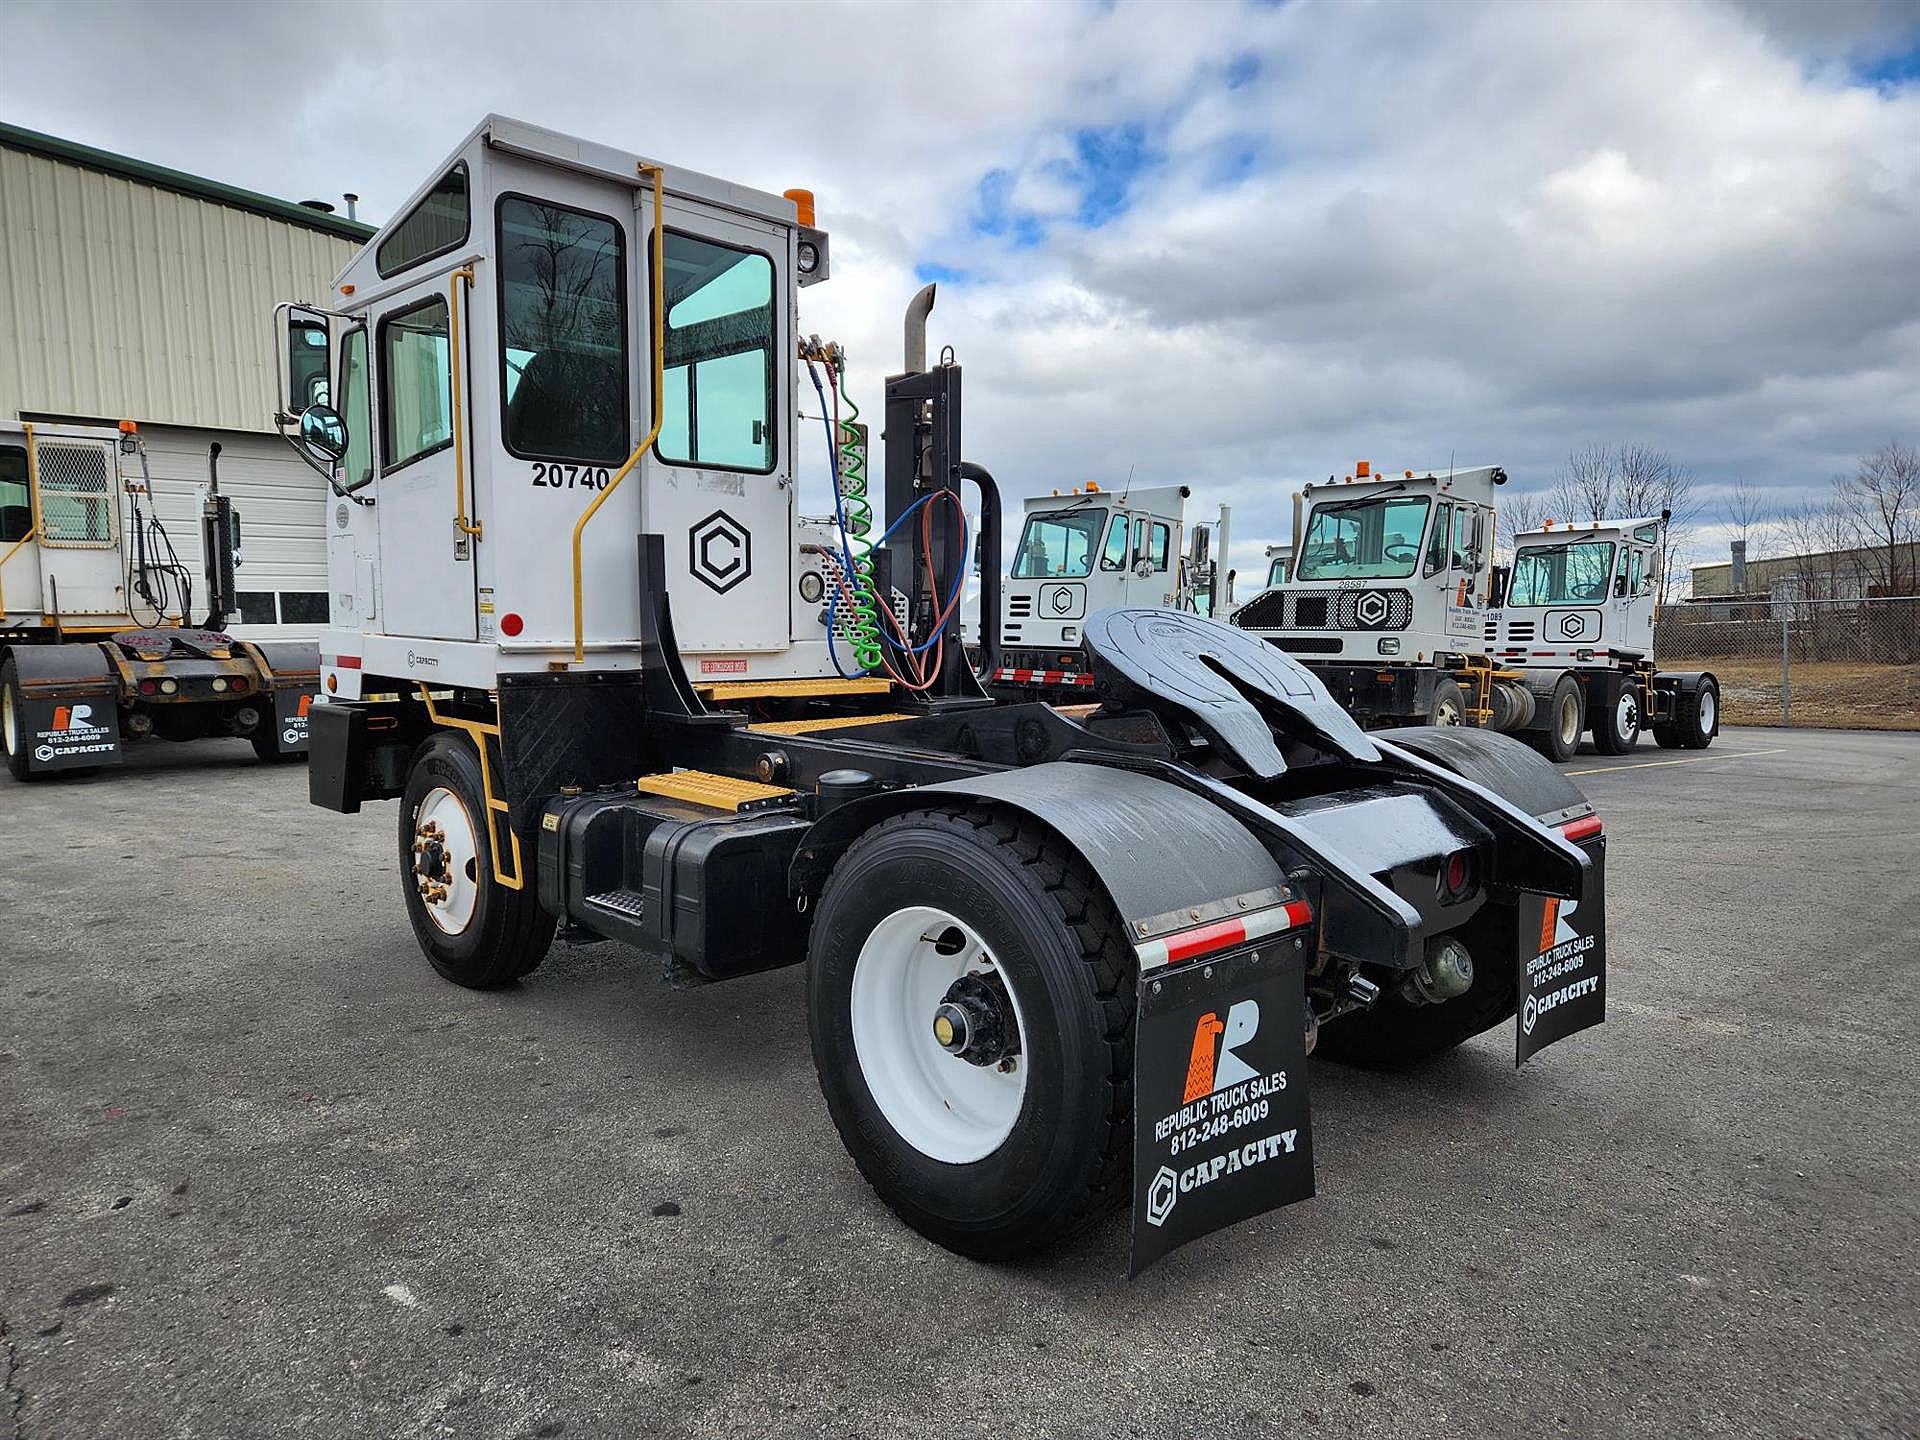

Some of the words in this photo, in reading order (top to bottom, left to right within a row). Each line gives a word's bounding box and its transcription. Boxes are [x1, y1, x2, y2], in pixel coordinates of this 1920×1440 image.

[532, 462, 610, 491] 20740
[1338, 581, 1368, 589] 28597
[37, 730, 67, 738] REPUBLIC
[55, 744, 115, 755] CAPACITY
[1526, 951, 1552, 976] REPUBLIC
[1552, 942, 1573, 961] TRUCK
[1573, 935, 1595, 953] SALES
[1533, 954, 1584, 988] 812-248-6009
[1537, 976, 1599, 1015] CAPACITY
[1155, 1099, 1208, 1142] REPUBLIC
[1210, 1084, 1249, 1116] TRUCK
[1250, 1071, 1287, 1098] SALES
[1171, 1099, 1269, 1156] 812-248-6009
[1179, 1129, 1298, 1193] CAPACITY
